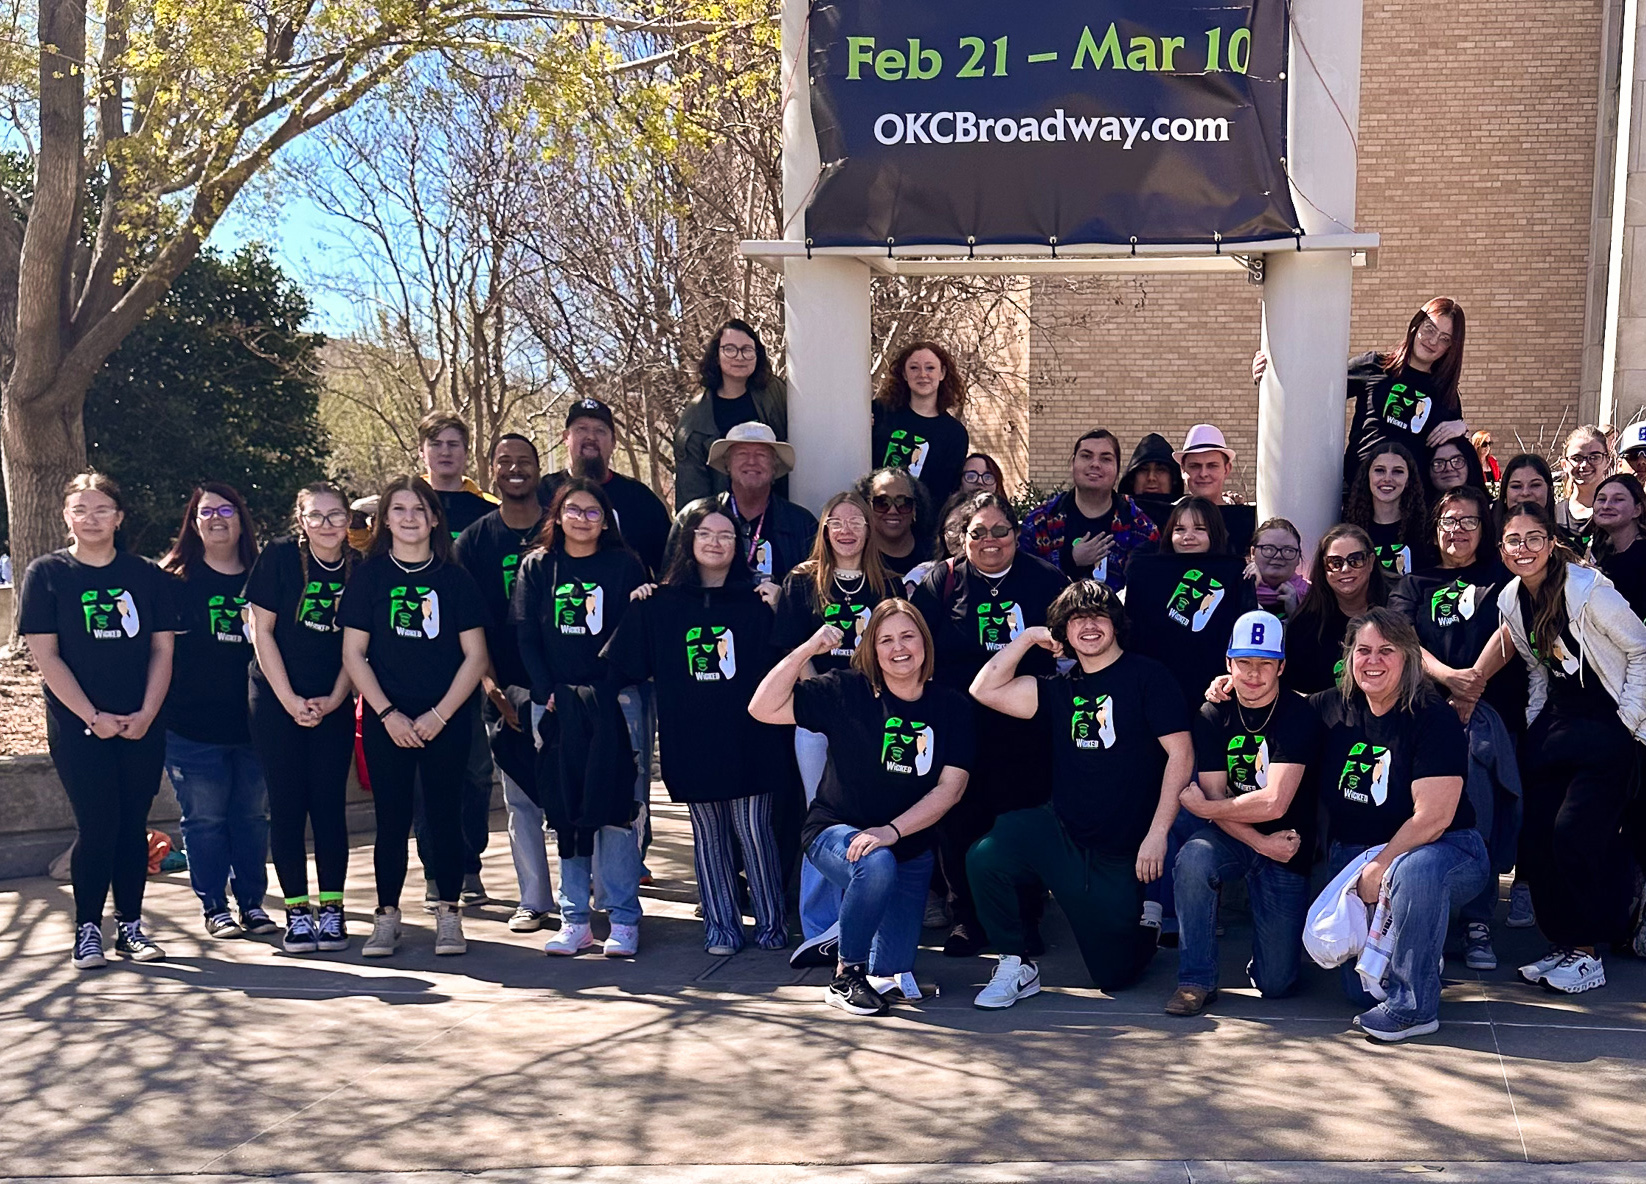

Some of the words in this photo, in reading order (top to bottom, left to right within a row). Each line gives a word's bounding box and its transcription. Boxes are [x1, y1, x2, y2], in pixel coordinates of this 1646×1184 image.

[846, 36, 943, 80] Feb
[956, 35, 1009, 78] 21
[1071, 22, 1185, 72] Mar
[1203, 26, 1251, 75] 10
[873, 109, 1230, 150] OKCBroadway.com
[1251, 623, 1265, 645] B
